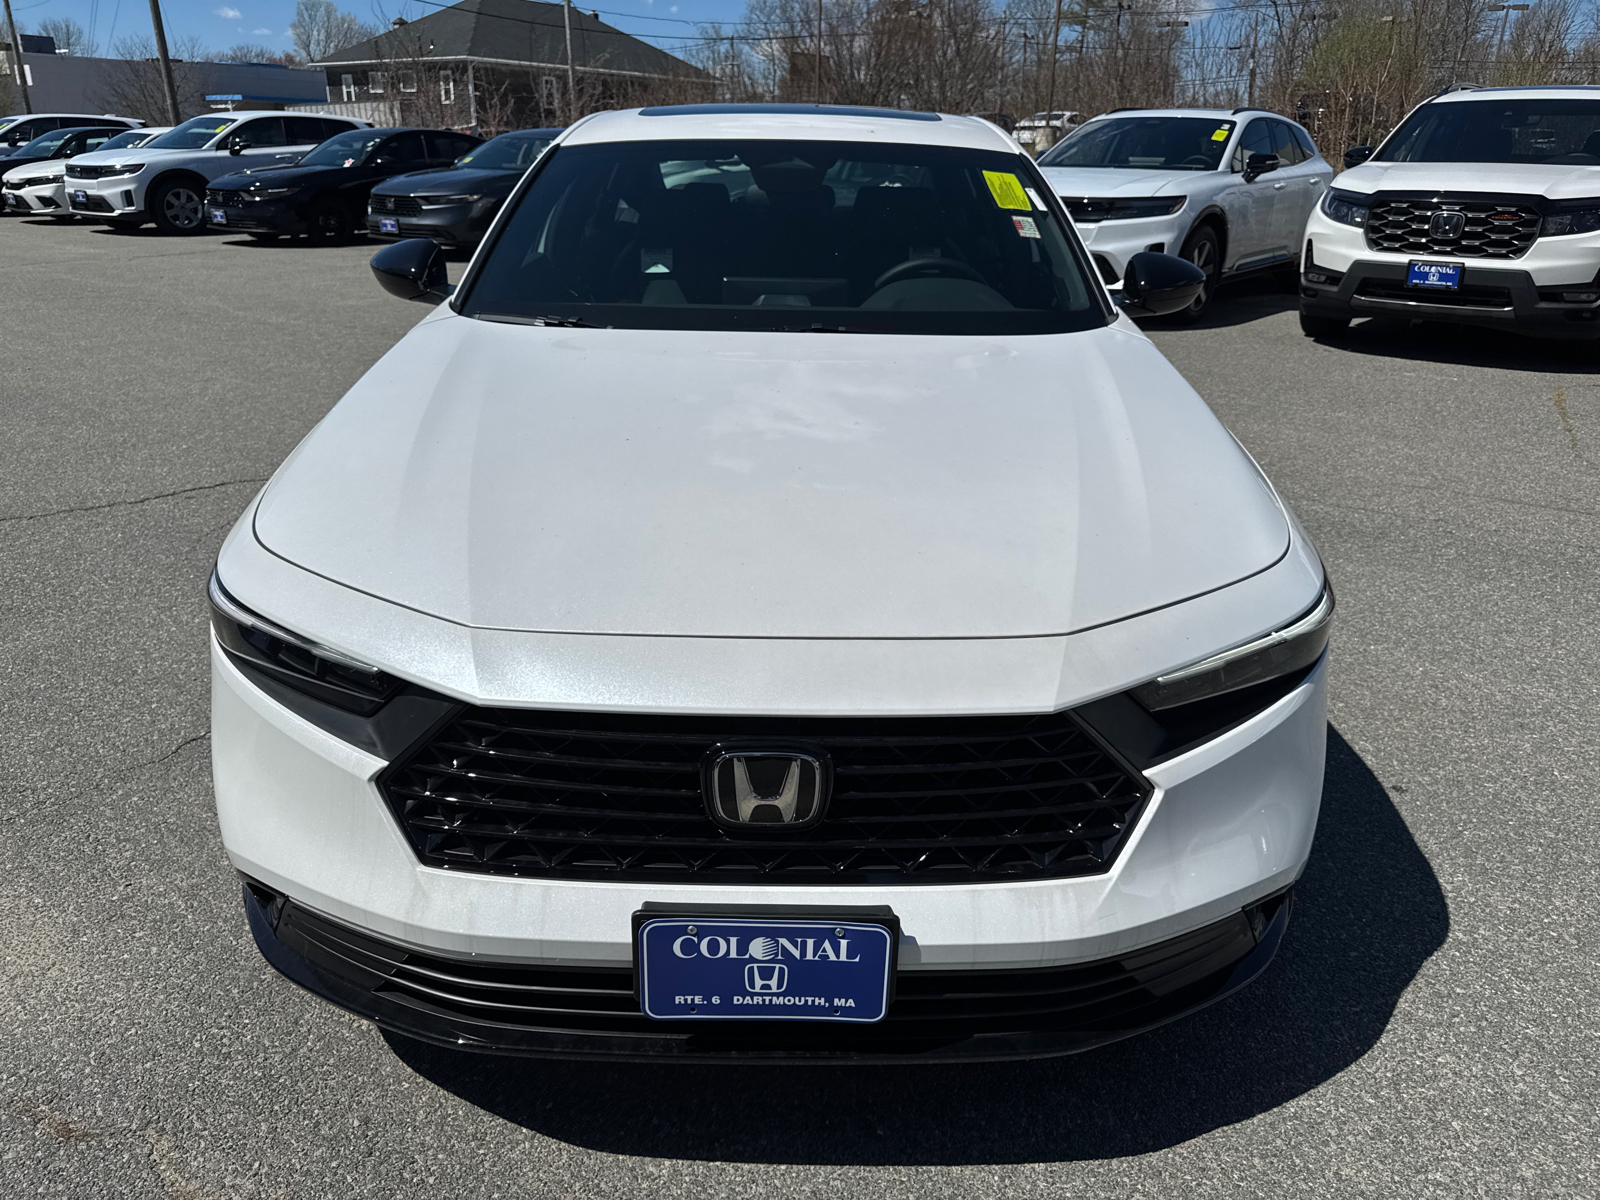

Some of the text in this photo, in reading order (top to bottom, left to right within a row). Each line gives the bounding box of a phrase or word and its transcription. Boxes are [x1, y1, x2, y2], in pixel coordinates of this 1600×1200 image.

[1414, 265, 1456, 274] COLONIAL
[672, 935, 861, 962] COLONIAL
[675, 995, 856, 1007] RTE. 6 DARTMOUTH, MA
